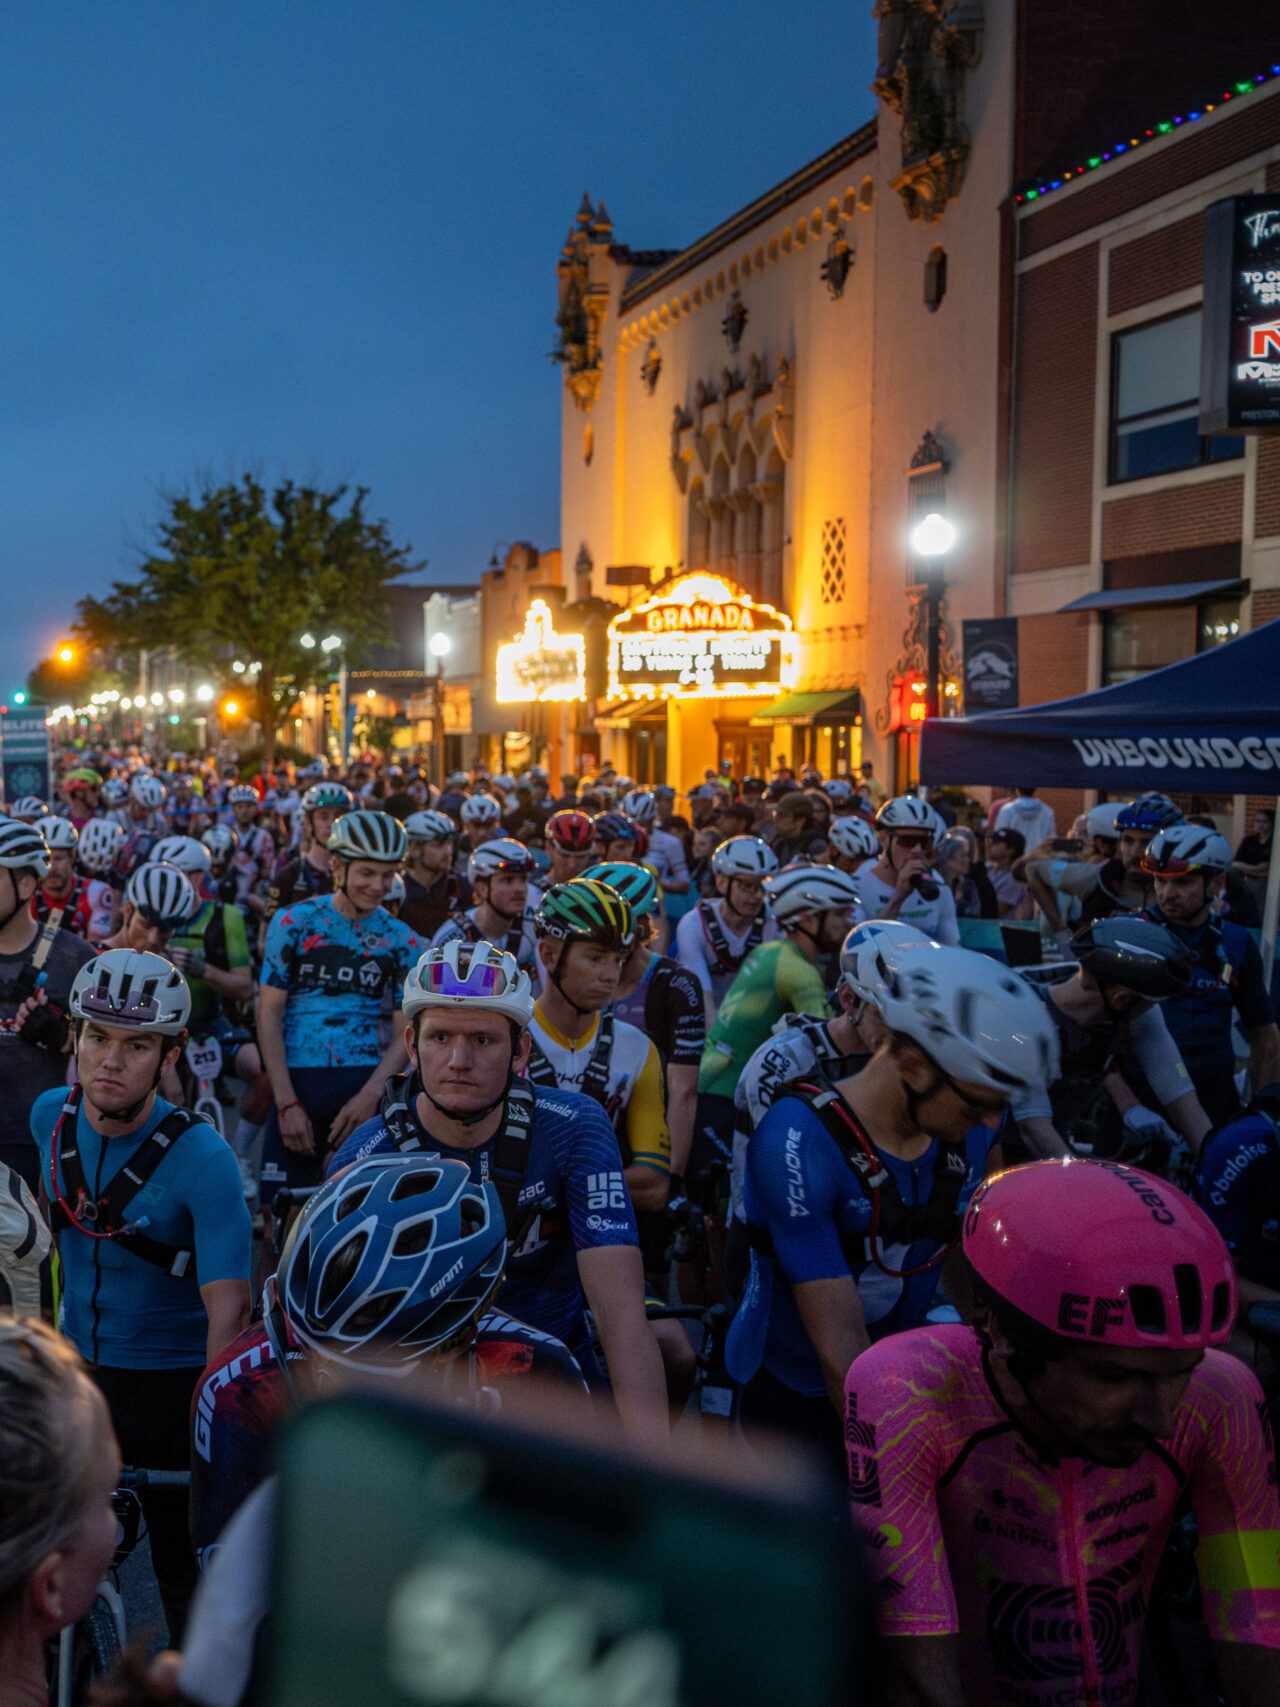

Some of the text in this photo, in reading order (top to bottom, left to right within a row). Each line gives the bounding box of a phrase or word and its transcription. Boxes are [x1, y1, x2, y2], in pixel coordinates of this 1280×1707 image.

[647, 604, 754, 633] GRANADA
[299, 963, 381, 987] FLOW
[193, 1051, 217, 1065] 213
[1217, 1142, 1269, 1192] baloise
[430, 1256, 464, 1299] GIANT
[193, 1340, 282, 1464] GIANT
[1085, 1483, 1157, 1523] easypost
[1093, 1523, 1150, 1550] wahoo
